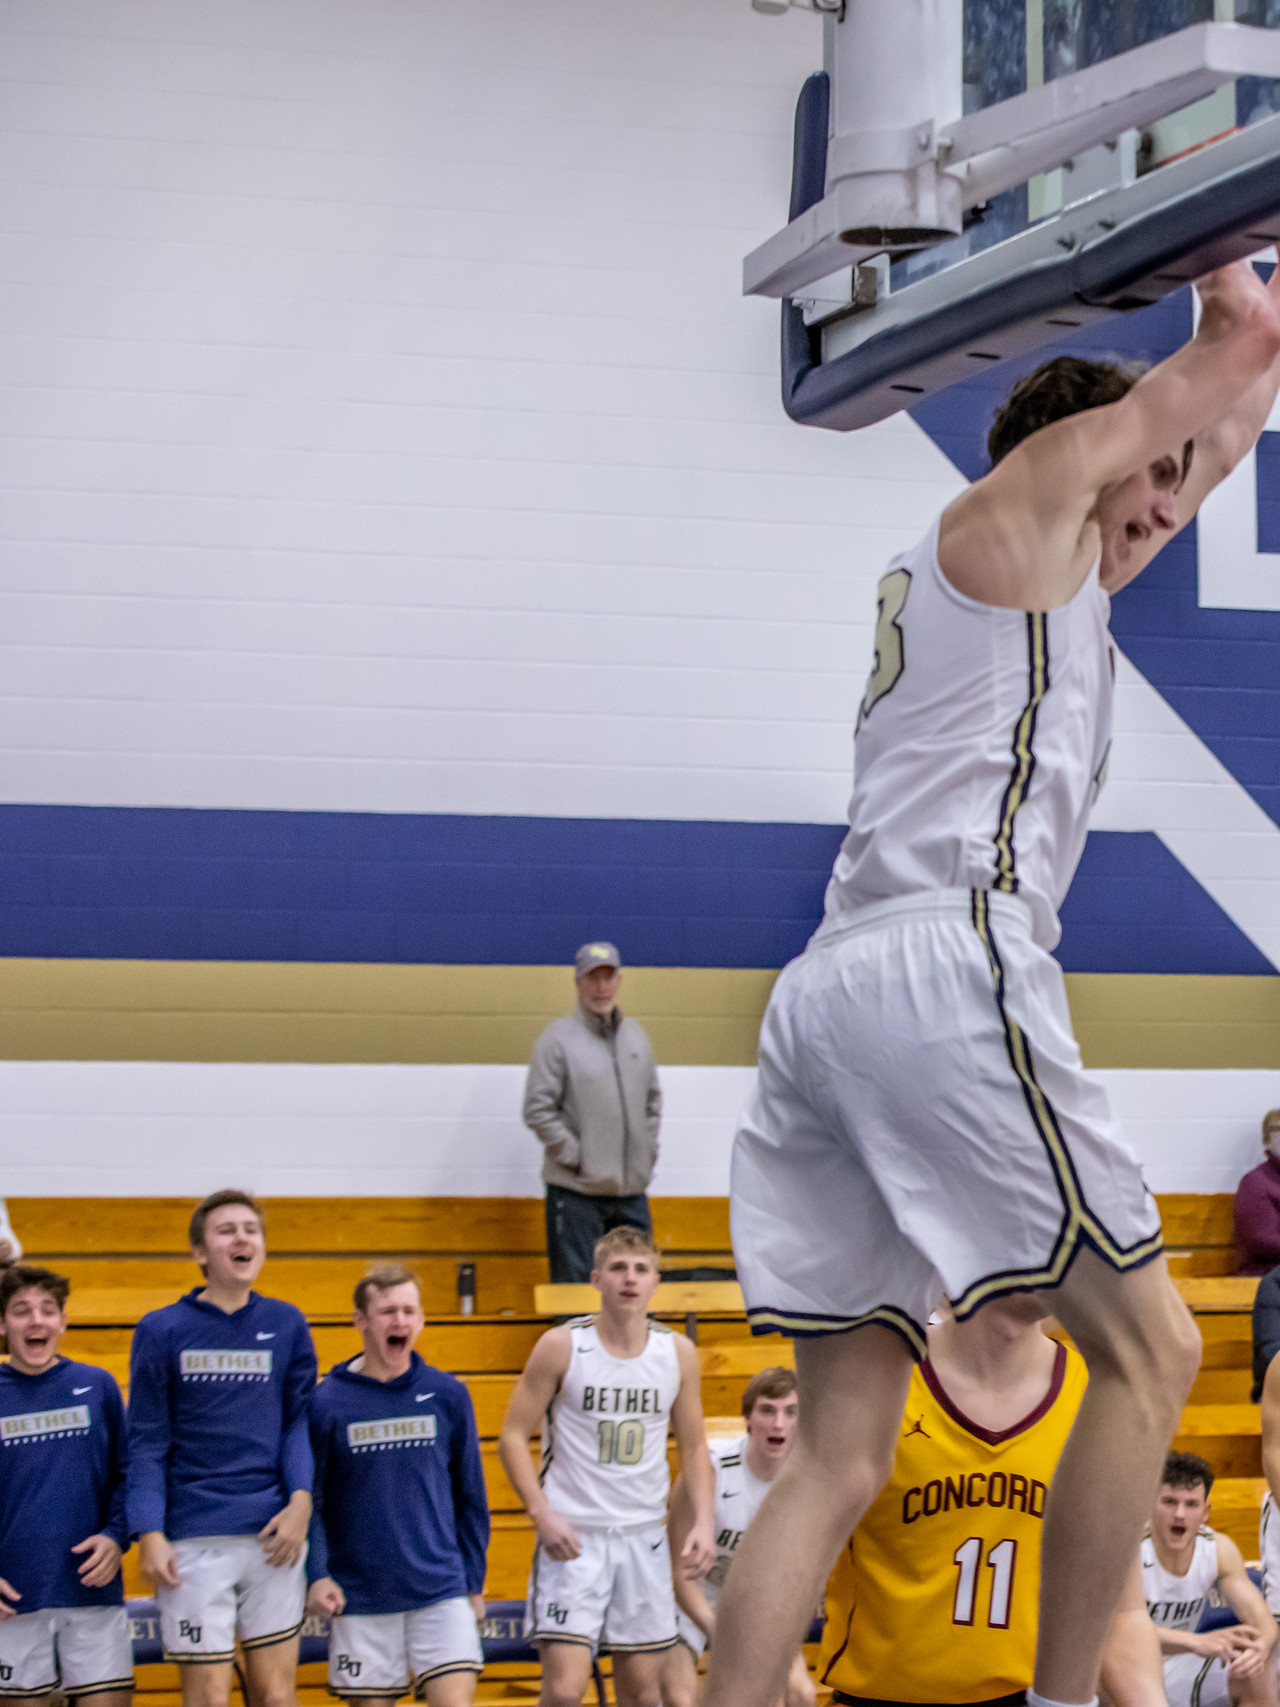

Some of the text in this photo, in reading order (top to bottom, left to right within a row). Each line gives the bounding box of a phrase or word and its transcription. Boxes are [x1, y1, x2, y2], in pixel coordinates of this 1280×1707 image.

[185, 1354, 265, 1370] BETHEL
[582, 1386, 662, 1413] BETHEL
[4, 1411, 82, 1434] BETHEL
[352, 1420, 431, 1442] BETHEL
[596, 1418, 645, 1466] 10
[902, 1471, 1047, 1524] CONCORD
[952, 1536, 1018, 1630] 11
[546, 1603, 568, 1625] BU
[179, 1619, 201, 1643] BU
[337, 1654, 361, 1676] BU
